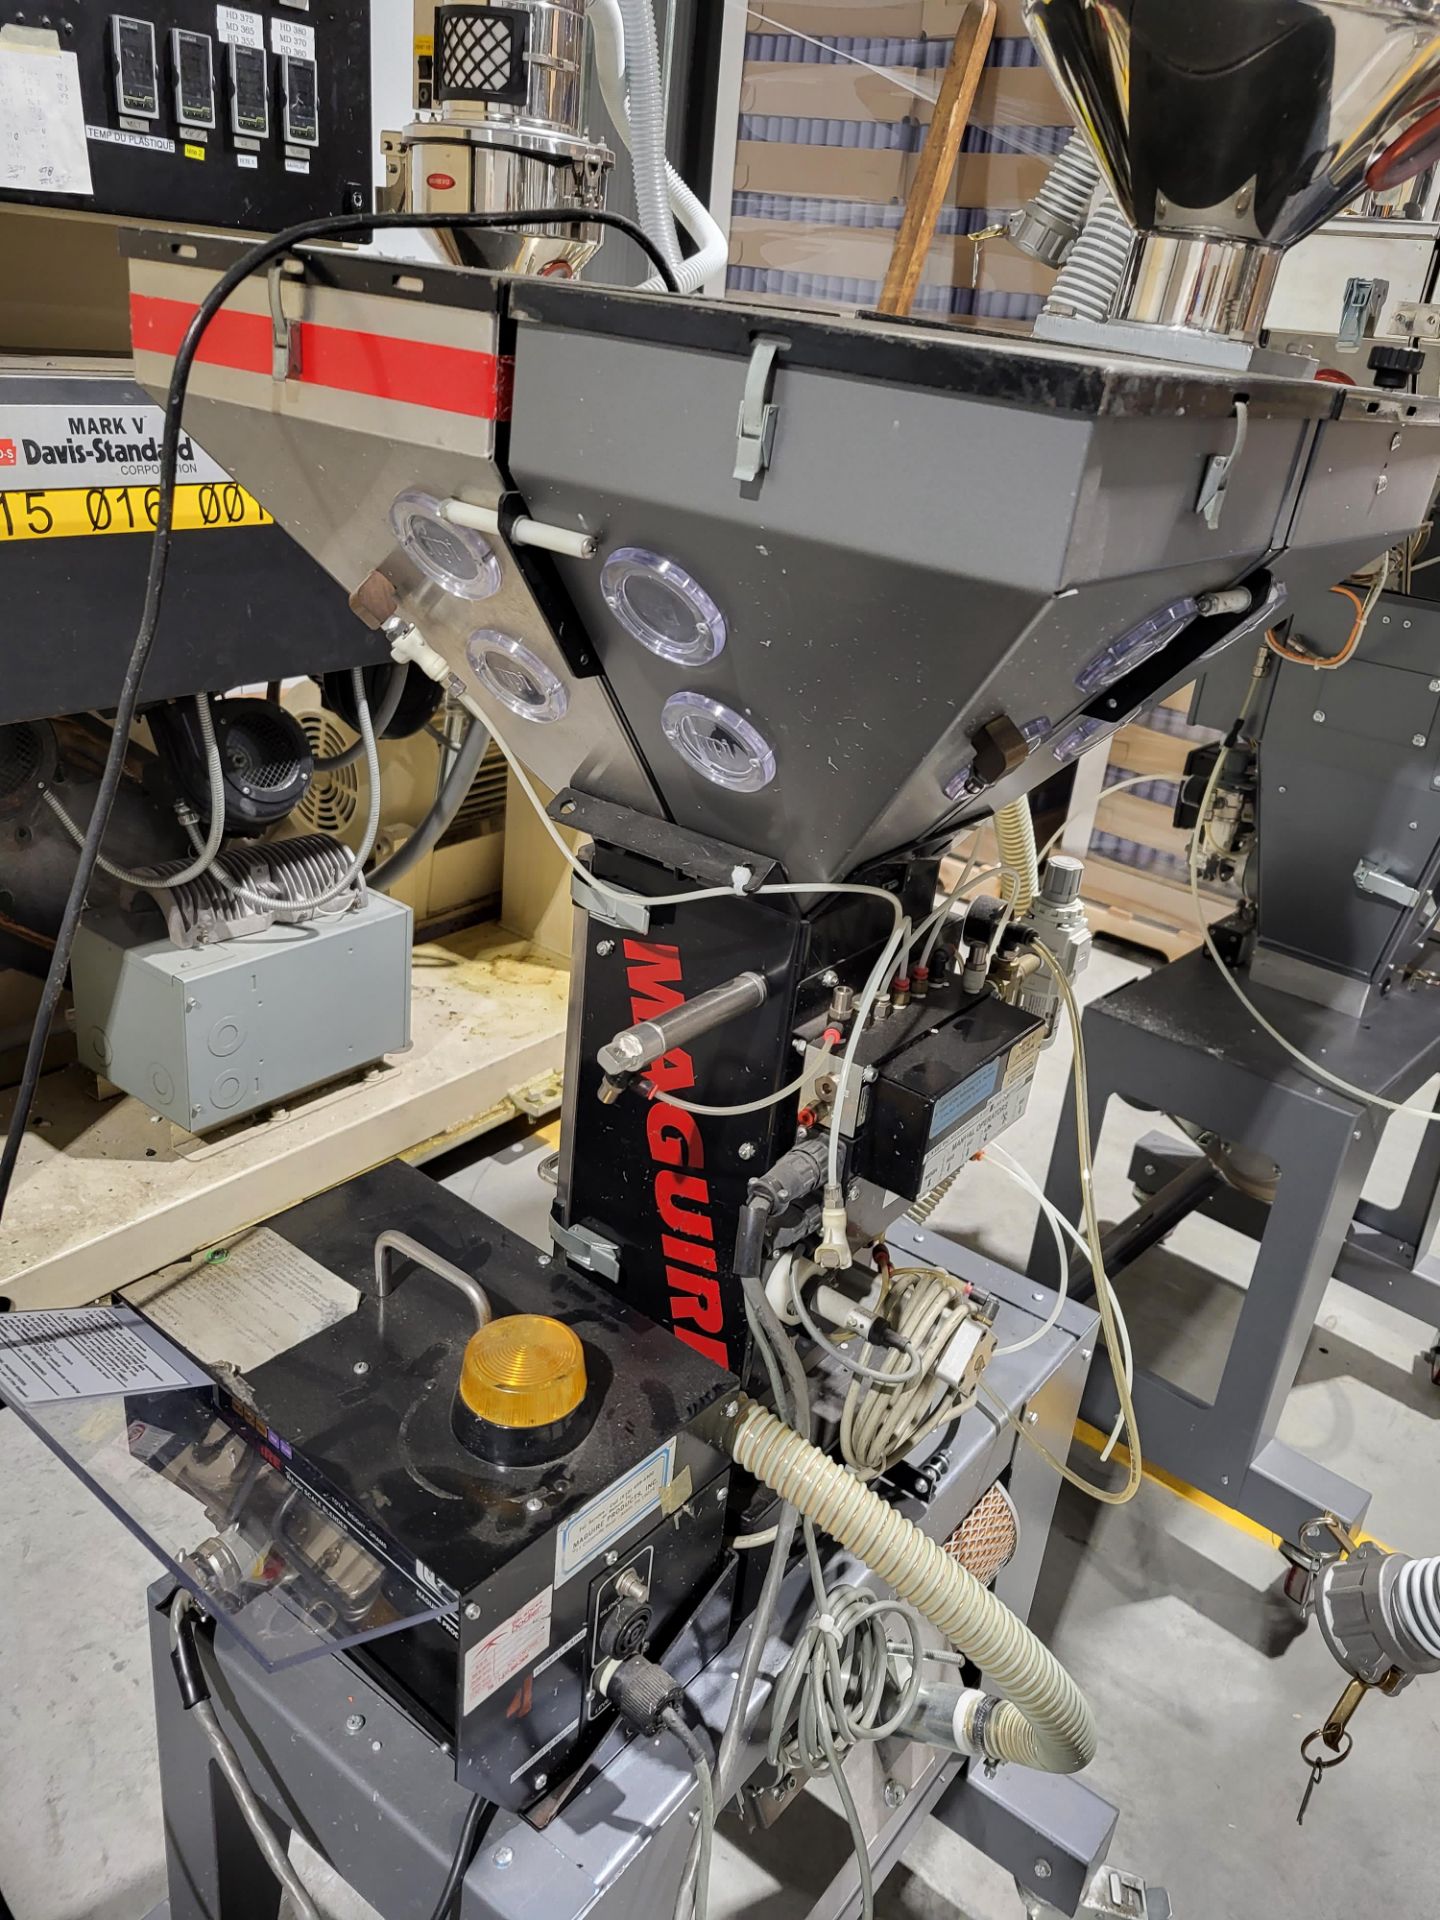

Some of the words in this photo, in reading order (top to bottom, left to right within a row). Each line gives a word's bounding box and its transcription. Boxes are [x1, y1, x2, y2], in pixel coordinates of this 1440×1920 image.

[226, 10, 238, 20] HD
[240, 14, 254, 24] 375
[225, 22, 238, 31] MD
[280, 22, 291, 32] HD
[240, 37, 255, 47] 355
[279, 34, 291, 43] MD
[293, 38, 307, 47] 370
[88, 127, 112, 140] TEMP
[114, 132, 126, 142] DU
[128, 135, 174, 151] PLASTIQUE
[68, 417, 127, 435] MARK
[131, 417, 143, 434] V
[22, 437, 194, 465] Davis-Standd
[121, 463, 197, 475] CORPOION
[623, 938, 730, 1370] MAGUIR
[304, 1489, 321, 1508] SCALE
[322, 1505, 349, 1531] BLENDER
[572, 1521, 604, 1548] MAGUIRE
